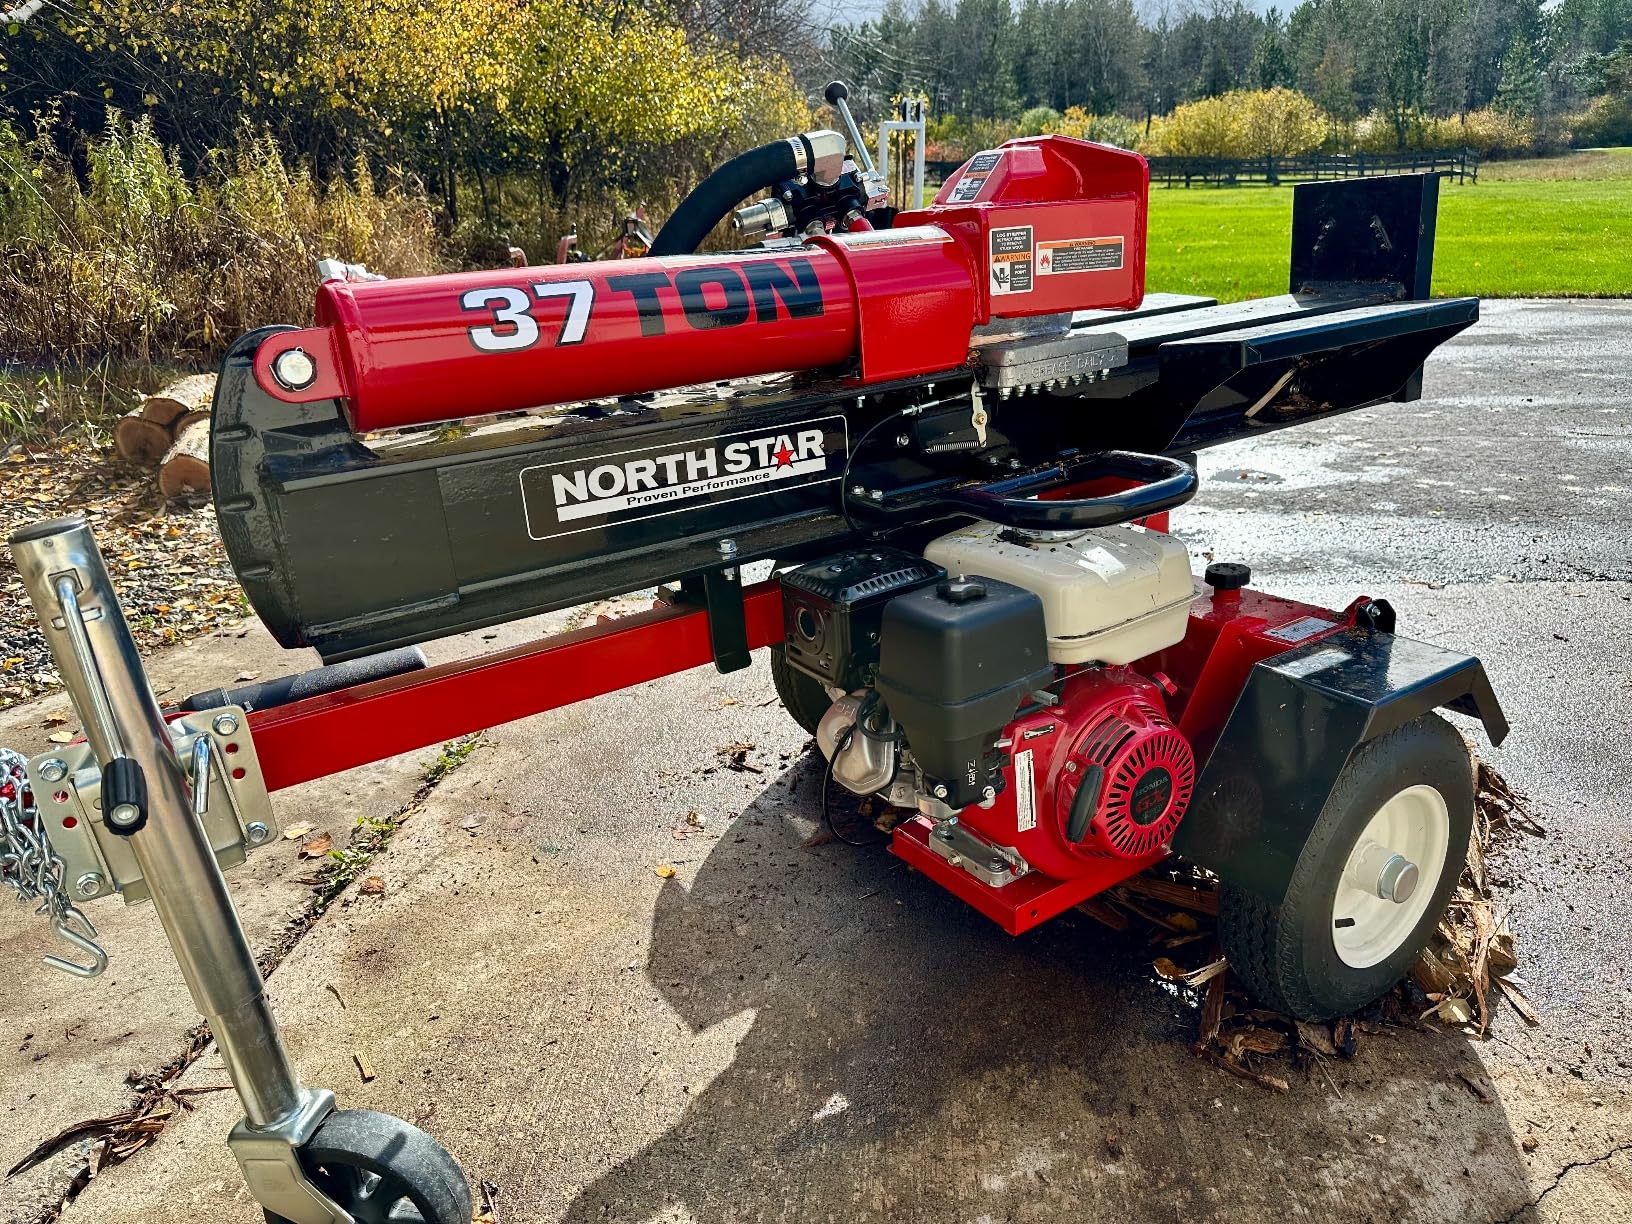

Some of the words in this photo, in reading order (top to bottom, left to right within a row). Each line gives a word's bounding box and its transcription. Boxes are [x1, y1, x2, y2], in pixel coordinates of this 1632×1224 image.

[1000, 252, 1031, 262] WARNING
[458, 277, 597, 354] 37
[603, 257, 825, 338] TON
[1031, 359, 1072, 379] GREASE
[551, 446, 718, 506] NORTH
[723, 428, 826, 474] STAR
[626, 488, 678, 507] Proven
[682, 470, 771, 496] Performance
[1134, 775, 1169, 797] HONDA
